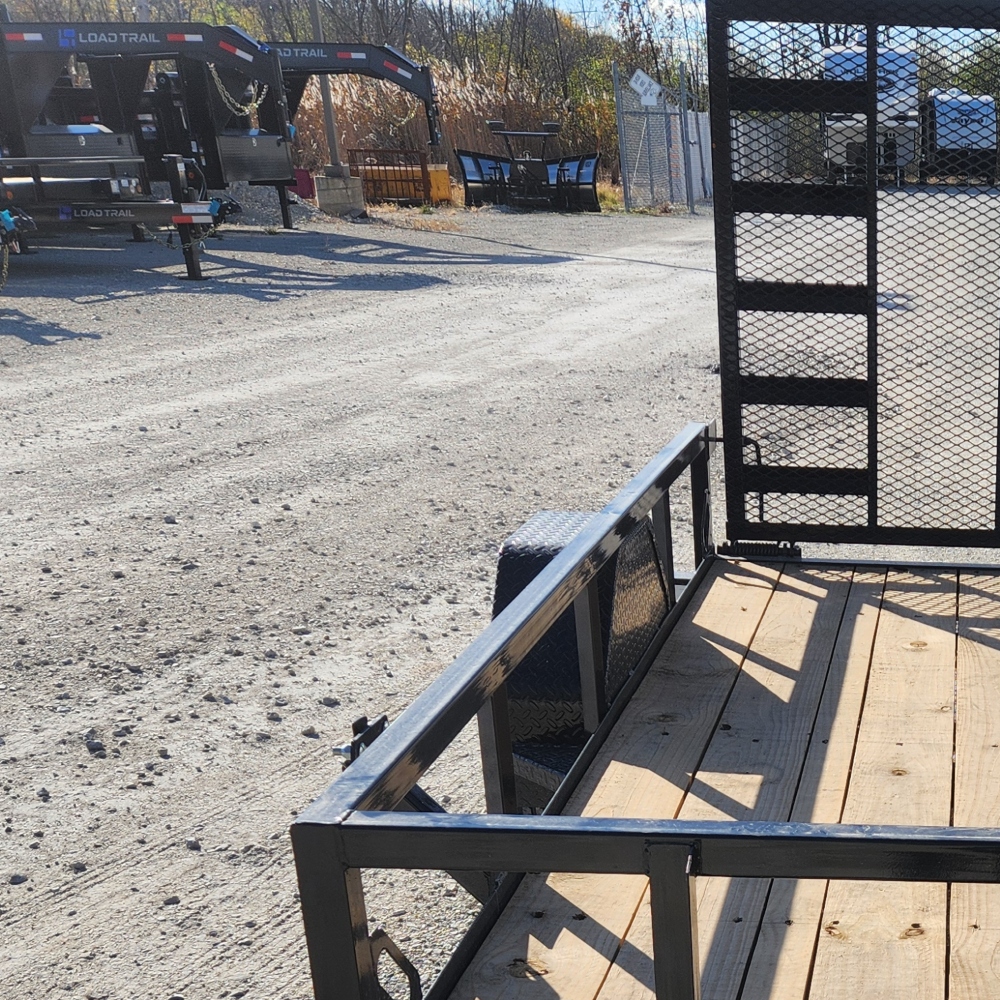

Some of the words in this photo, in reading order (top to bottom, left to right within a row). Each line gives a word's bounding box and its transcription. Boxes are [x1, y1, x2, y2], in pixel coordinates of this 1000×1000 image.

[79, 32, 118, 43] LOAD
[120, 32, 160, 43] TRAIL
[293, 48, 328, 58] TRAIL
[74, 209, 103, 218] LOAD
[104, 209, 135, 218] TRAIL
